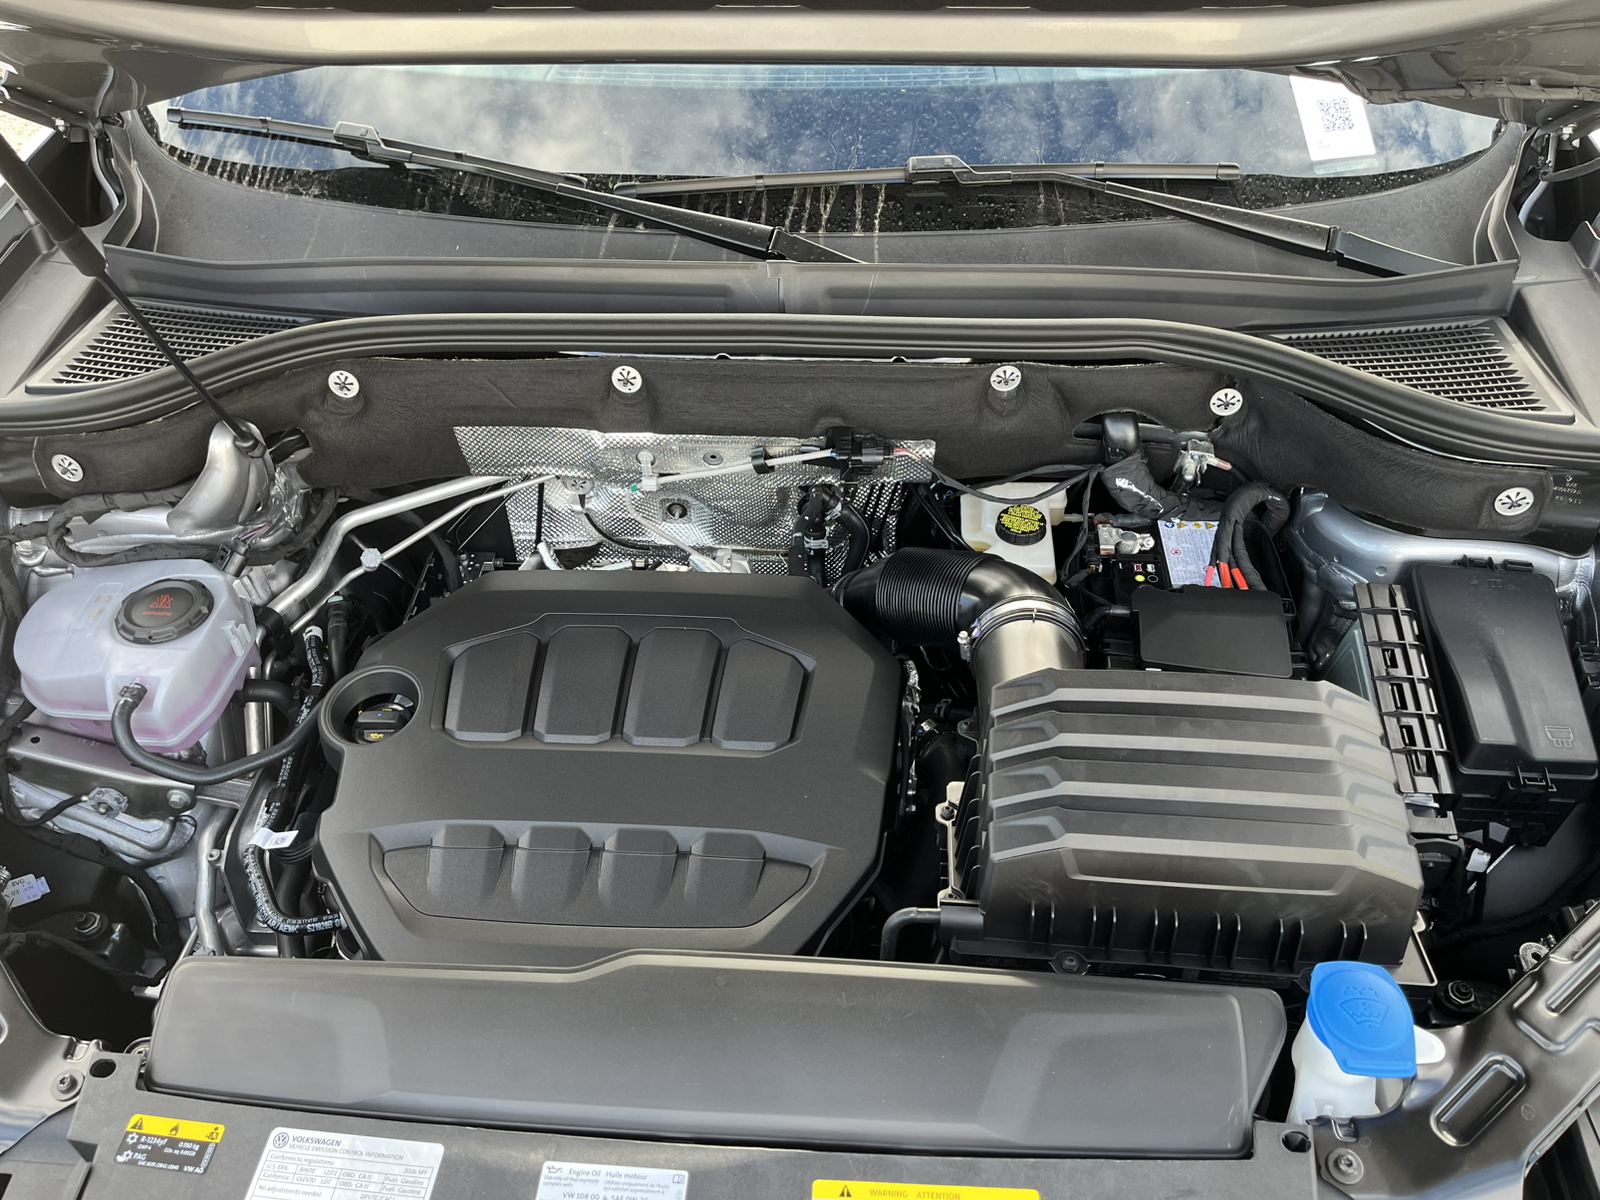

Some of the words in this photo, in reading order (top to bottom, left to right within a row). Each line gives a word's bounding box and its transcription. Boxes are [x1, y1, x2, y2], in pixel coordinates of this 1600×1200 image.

[292, 1135, 342, 1147] VOLKSWAGEN
[289, 1143, 311, 1151] VEHICLE
[311, 1145, 339, 1154] EMISSION
[338, 1148, 364, 1157] CONTROL
[365, 1151, 404, 1161] INFORMATION
[270, 1153, 296, 1162] Conforms
[303, 1157, 336, 1166] regulations:
[403, 1167, 417, 1175] 2026
[569, 1168, 591, 1177] Engine
[591, 1169, 601, 1177] Oil
[605, 1170, 623, 1179] Huile
[624, 1172, 648, 1180] moteur
[262, 1172, 290, 1181] California:
[382, 1185, 396, 1193] Fuel:
[398, 1186, 422, 1195] Gasoline
[401, 1177, 425, 1186] Gasoline
[266, 1185, 301, 1195] adjustments
[301, 1189, 322, 1198] needed
[869, 1188, 908, 1198] WARNING
[916, 1191, 961, 1200] ATTENTION
